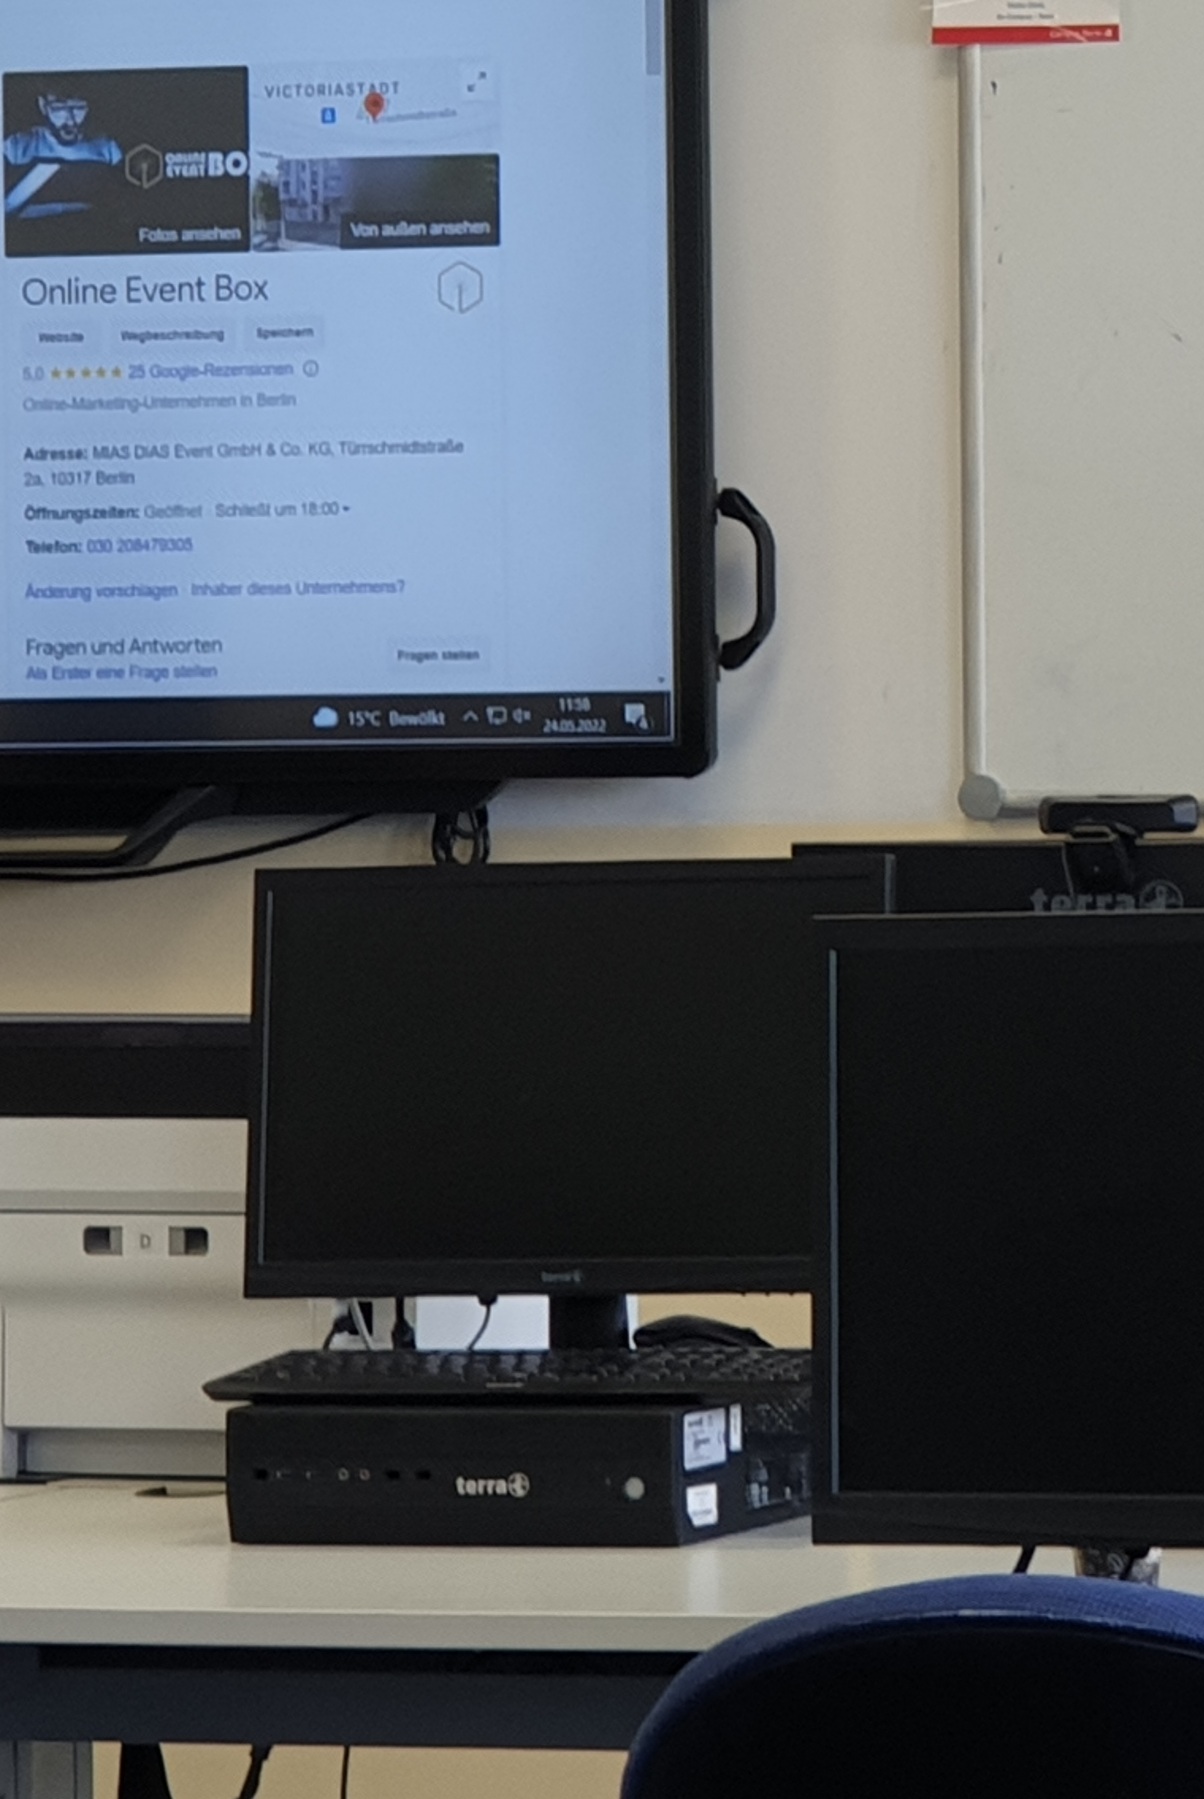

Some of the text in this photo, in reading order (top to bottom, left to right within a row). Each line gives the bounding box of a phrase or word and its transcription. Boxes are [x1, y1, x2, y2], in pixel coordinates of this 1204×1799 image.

[138, 224, 242, 242] Fotos ansehen
[350, 219, 492, 238] Von außen ansehen
[21, 273, 270, 306] Online Event Box
[38, 331, 85, 344] Website
[120, 329, 225, 344] Wegbeschreibung
[256, 325, 314, 341] Speichern
[128, 361, 295, 382] 25 Google-Rezensionen
[240, 393, 254, 407] in
[256, 392, 298, 408] Berlin
[23, 446, 88, 461] Adresse:
[174, 443, 214, 459] Event
[217, 442, 262, 458] GmbH
[266, 442, 277, 457] &
[50, 469, 92, 486] 10317
[95, 469, 136, 486] Berlin
[23, 500, 340, 524] Öffnungszeiten: Geöffnet Schließt um 18:00
[25, 539, 83, 554] Telefon:
[86, 538, 113, 554] 030
[25, 579, 406, 602] Änderung vorschlagen Inhaber dieses Unternehmens?
[25, 637, 224, 660] Fragen und Antworten
[396, 649, 480, 663] Fragen stellen
[25, 663, 219, 683] Als Erster eine Frage stellen
[348, 708, 446, 728] 15°C Bewölkt
[1030, 886, 1137, 912] terra
[455, 1475, 508, 1496] terra
